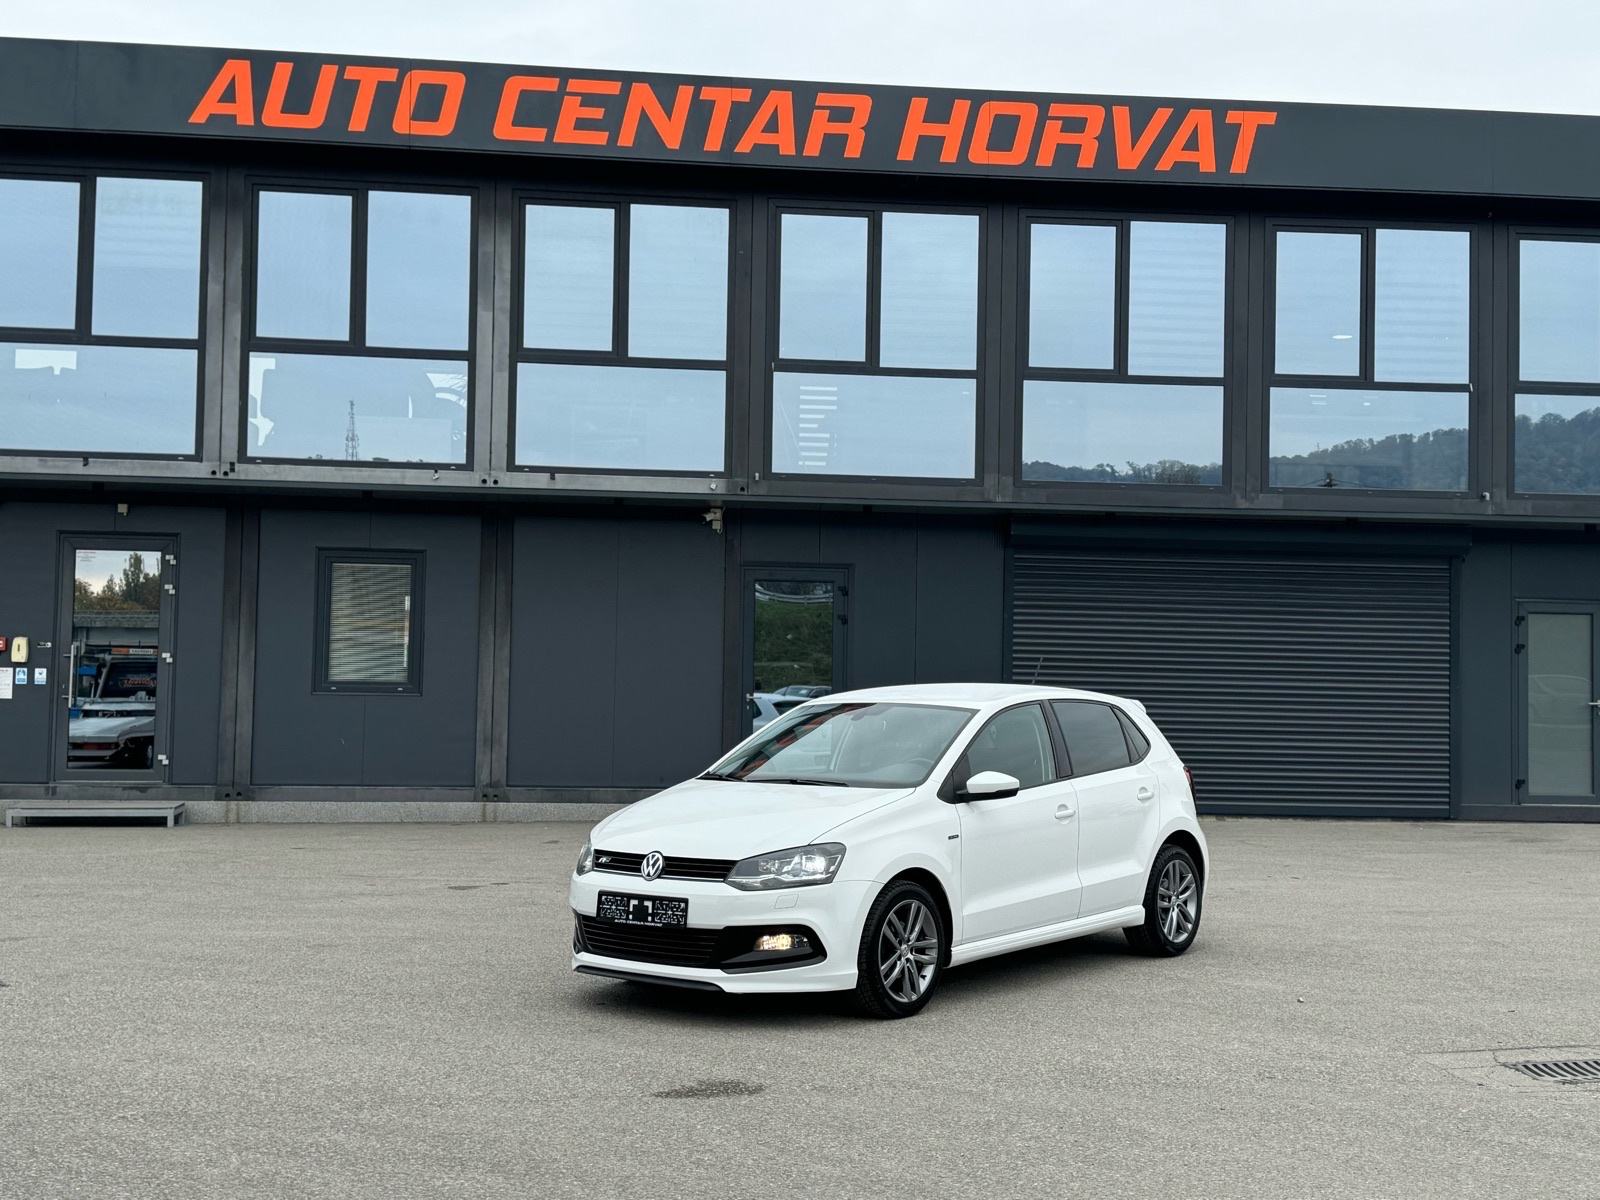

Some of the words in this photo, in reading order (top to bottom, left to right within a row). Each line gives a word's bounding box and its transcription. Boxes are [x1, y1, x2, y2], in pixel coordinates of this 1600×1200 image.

[190, 59, 466, 137] AUTO
[493, 76, 873, 158] CENTAR
[897, 96, 1277, 174] HORVAT
